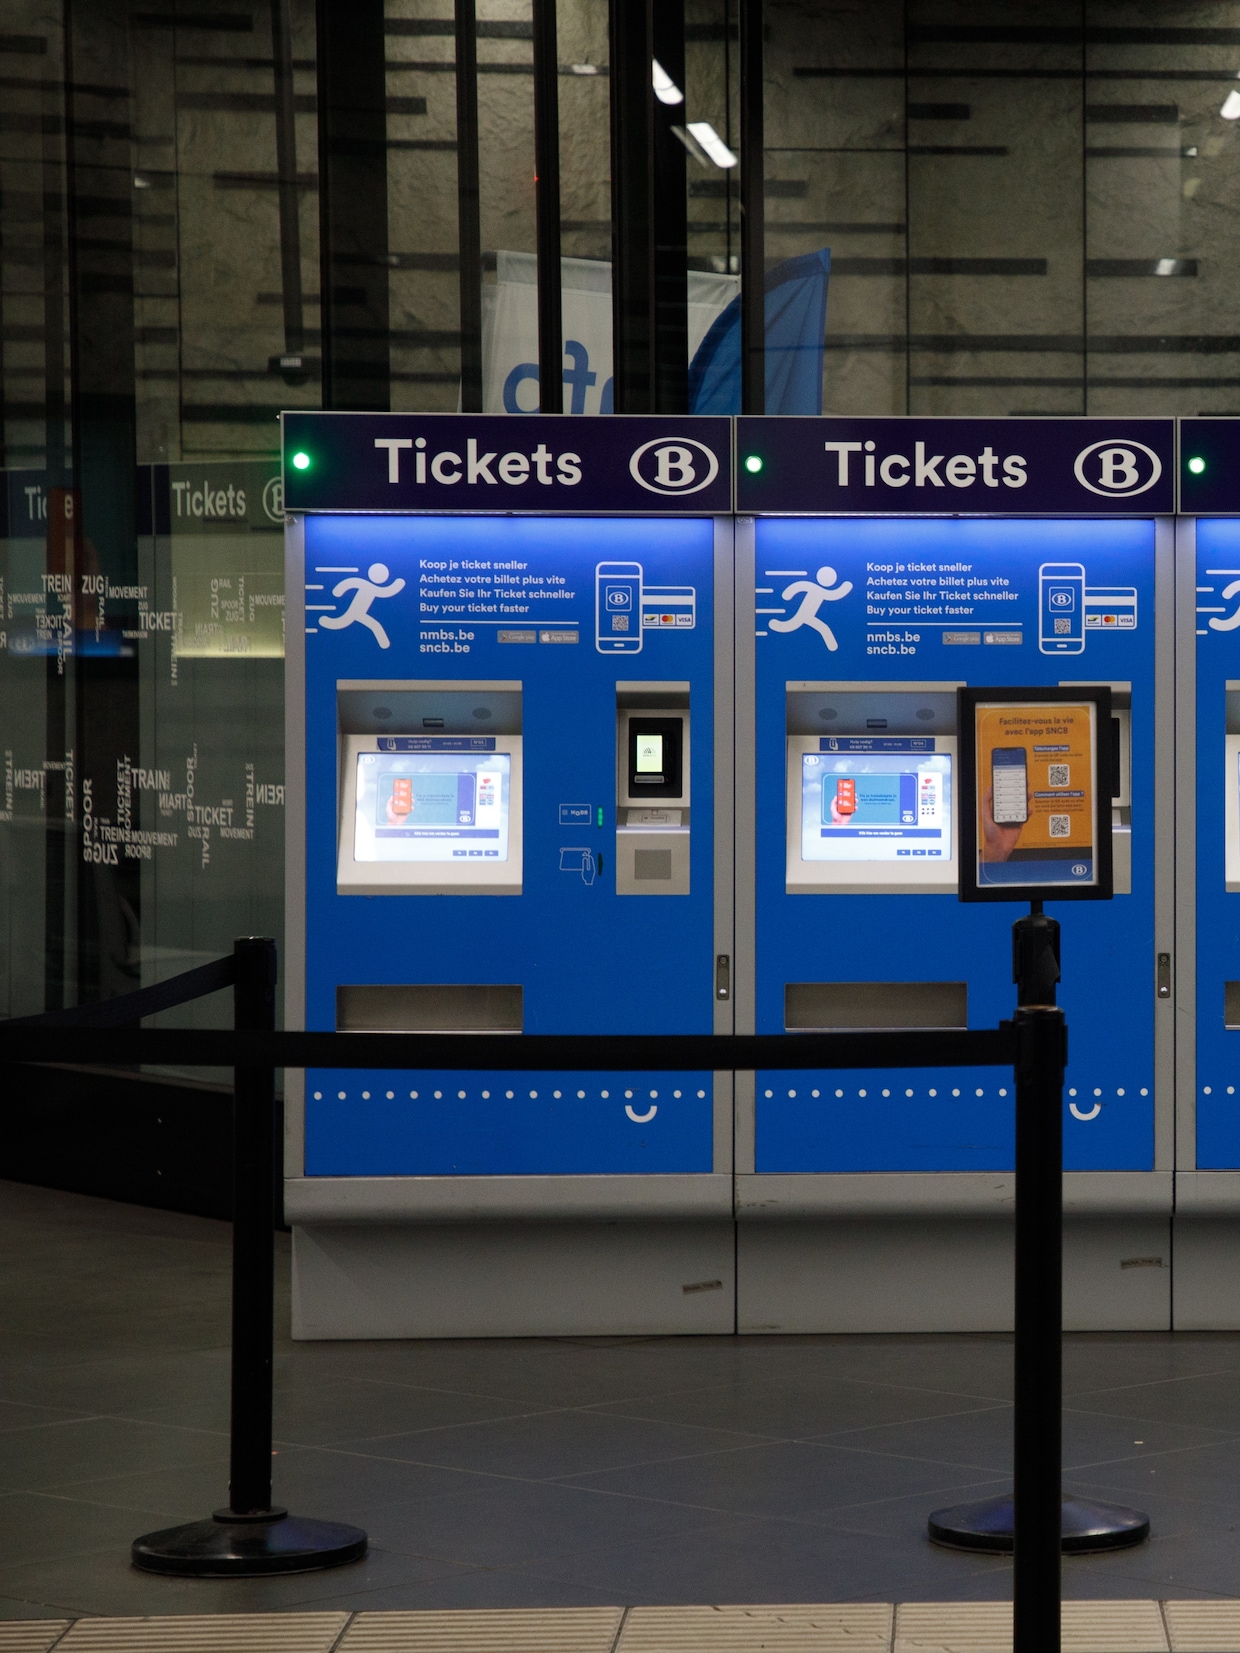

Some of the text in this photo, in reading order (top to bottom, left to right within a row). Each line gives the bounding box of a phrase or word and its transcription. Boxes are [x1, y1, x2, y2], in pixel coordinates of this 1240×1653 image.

[375, 438, 582, 485] Tickets
[825, 441, 1027, 487] Tickets
[172, 480, 246, 516] Tickets
[419, 559, 528, 571] Koop je ticket sneller
[866, 562, 973, 574] Koop je ticket sneller
[41, 574, 71, 592] TREIN
[82, 575, 104, 593] ZUG
[419, 573, 566, 586] Achetez votre billet plus vite
[866, 576, 1010, 588] Achetez votre billet plus vite
[109, 586, 147, 598] MOVEMENT
[419, 588, 576, 599] Kaufen Sie Ihr Ticket schneller
[866, 590, 1019, 601] Kaufen Sie Ihr Ticket schneller
[255, 595, 285, 605] MOUVEME
[419, 602, 530, 614] Buy your ticket faster
[866, 604, 974, 617] Buy your ticket faster
[139, 612, 177, 630] TICKET
[63, 604, 72, 662] RAIL
[419, 628, 475, 641] nmbs.be
[866, 630, 921, 643] nmbs.be
[419, 641, 471, 654] sncb.be
[866, 643, 917, 655] sncb.be
[999, 716, 1074, 725] Facilitez-vous la vie
[1046, 727, 1068, 735] SNCB
[65, 748, 74, 822] TICKET
[131, 768, 167, 790] TRAIN
[83, 779, 92, 862] SPOOR
[195, 805, 234, 826] TICKET
[100, 825, 125, 842] TREIN
[131, 830, 178, 847] MOUVEMENT
[202, 827, 210, 869] RAIL
